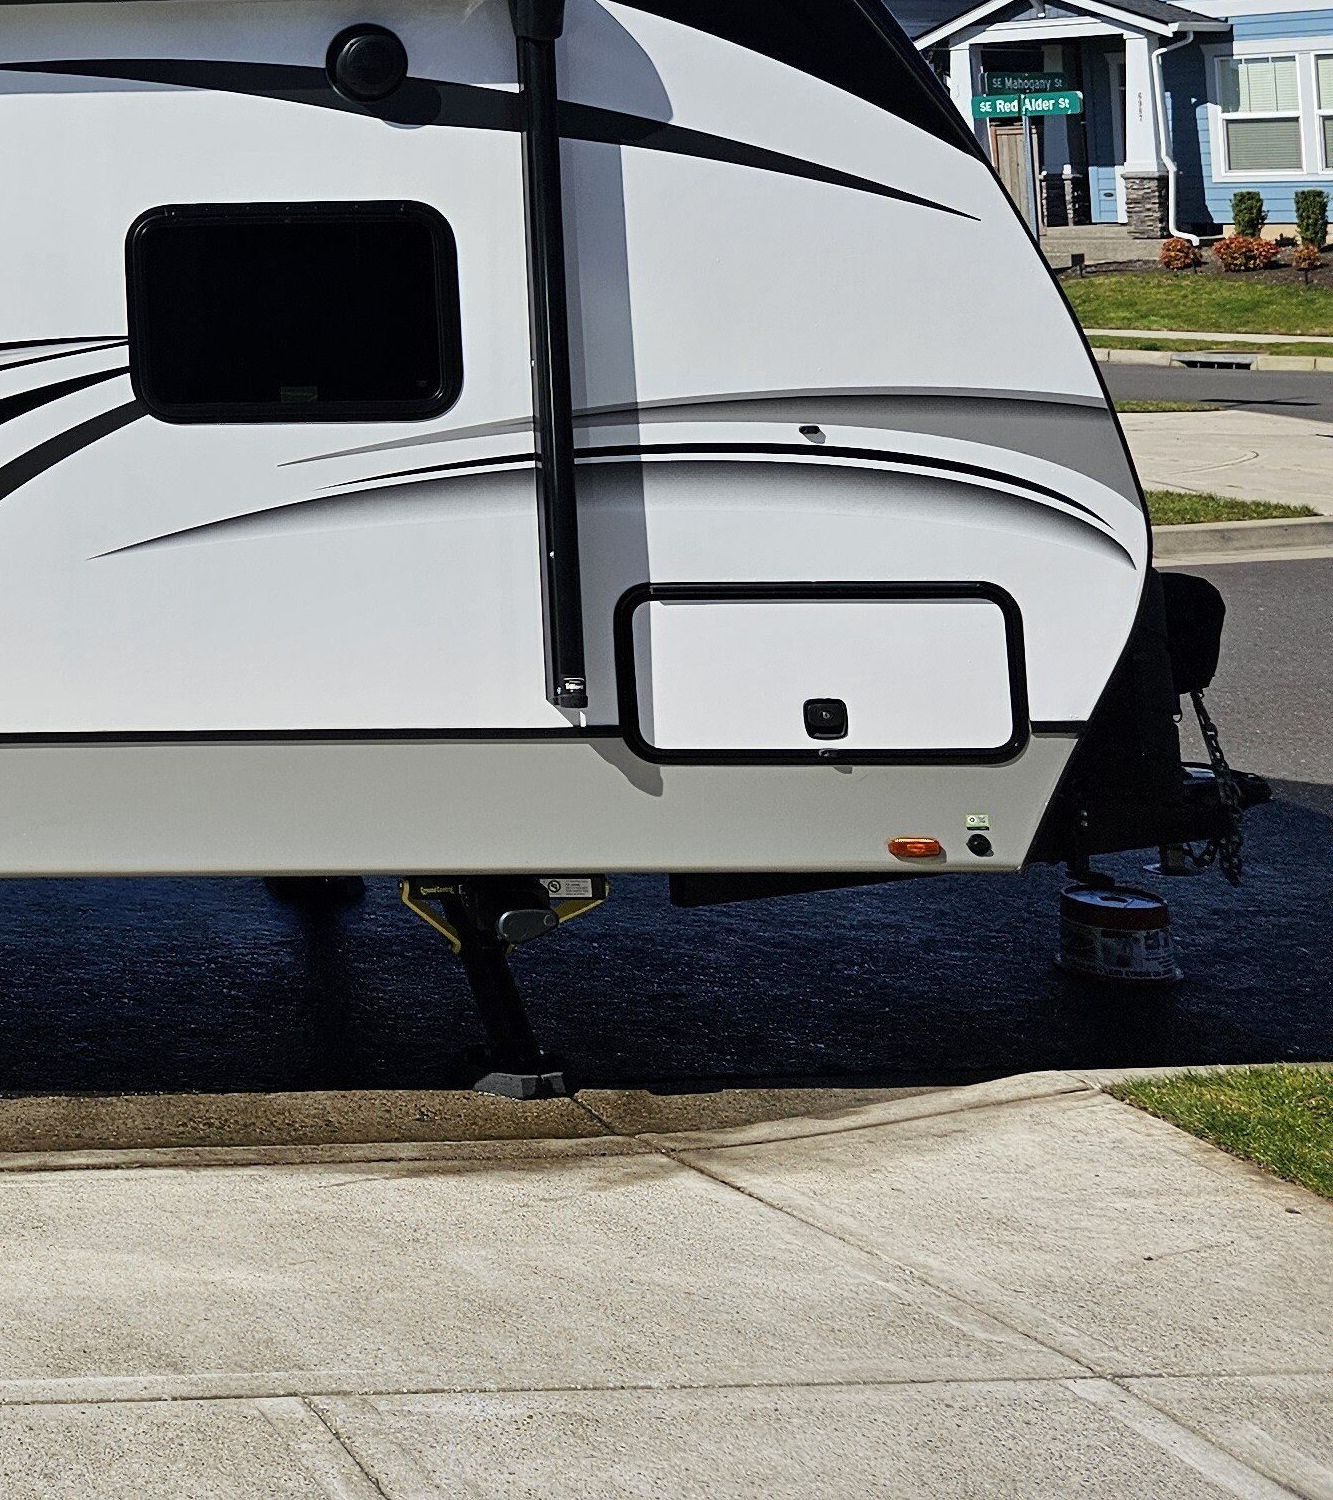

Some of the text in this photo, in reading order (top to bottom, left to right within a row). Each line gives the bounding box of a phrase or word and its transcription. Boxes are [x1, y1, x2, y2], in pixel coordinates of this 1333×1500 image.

[993, 77, 1063, 91] SE Mahogany St
[979, 97, 1070, 113] SE Red Alder St
